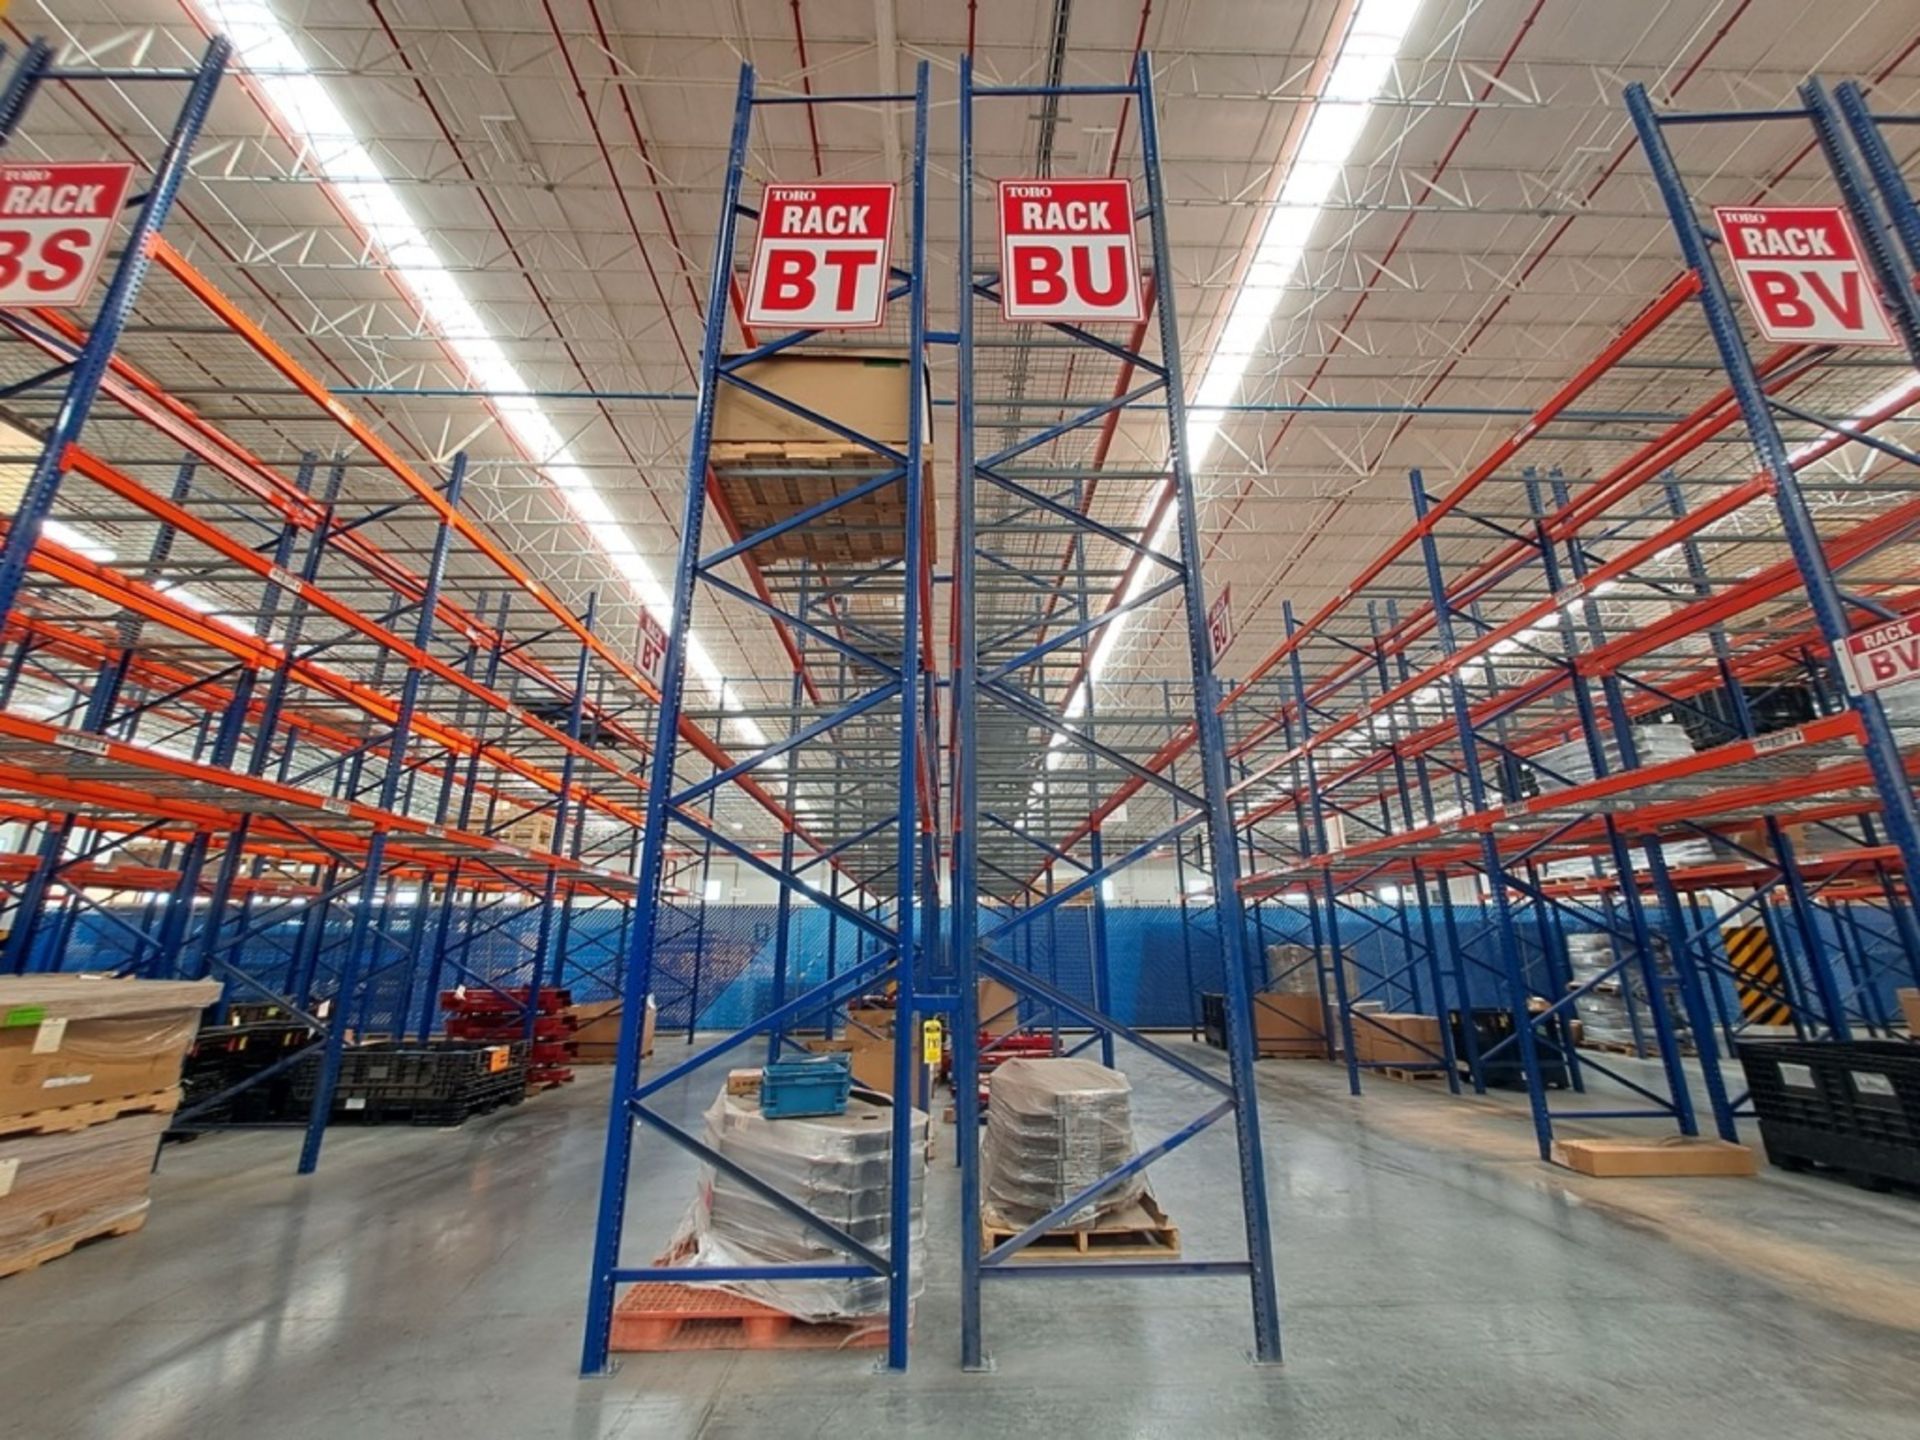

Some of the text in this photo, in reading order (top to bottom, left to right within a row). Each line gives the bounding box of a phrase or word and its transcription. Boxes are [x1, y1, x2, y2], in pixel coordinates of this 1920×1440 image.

[2, 184, 106, 214] RACK
[772, 190, 816, 202] TORO
[1006, 187, 1052, 198] TORO
[781, 205, 871, 235] RACK
[1021, 201, 1112, 231] RACK
[1740, 227, 1835, 257] RACK
[760, 249, 878, 311] BT
[1013, 246, 1129, 307] BU
[1747, 270, 1864, 330] BV
[1862, 621, 1914, 649] RACK
[1868, 640, 1920, 681] BV
